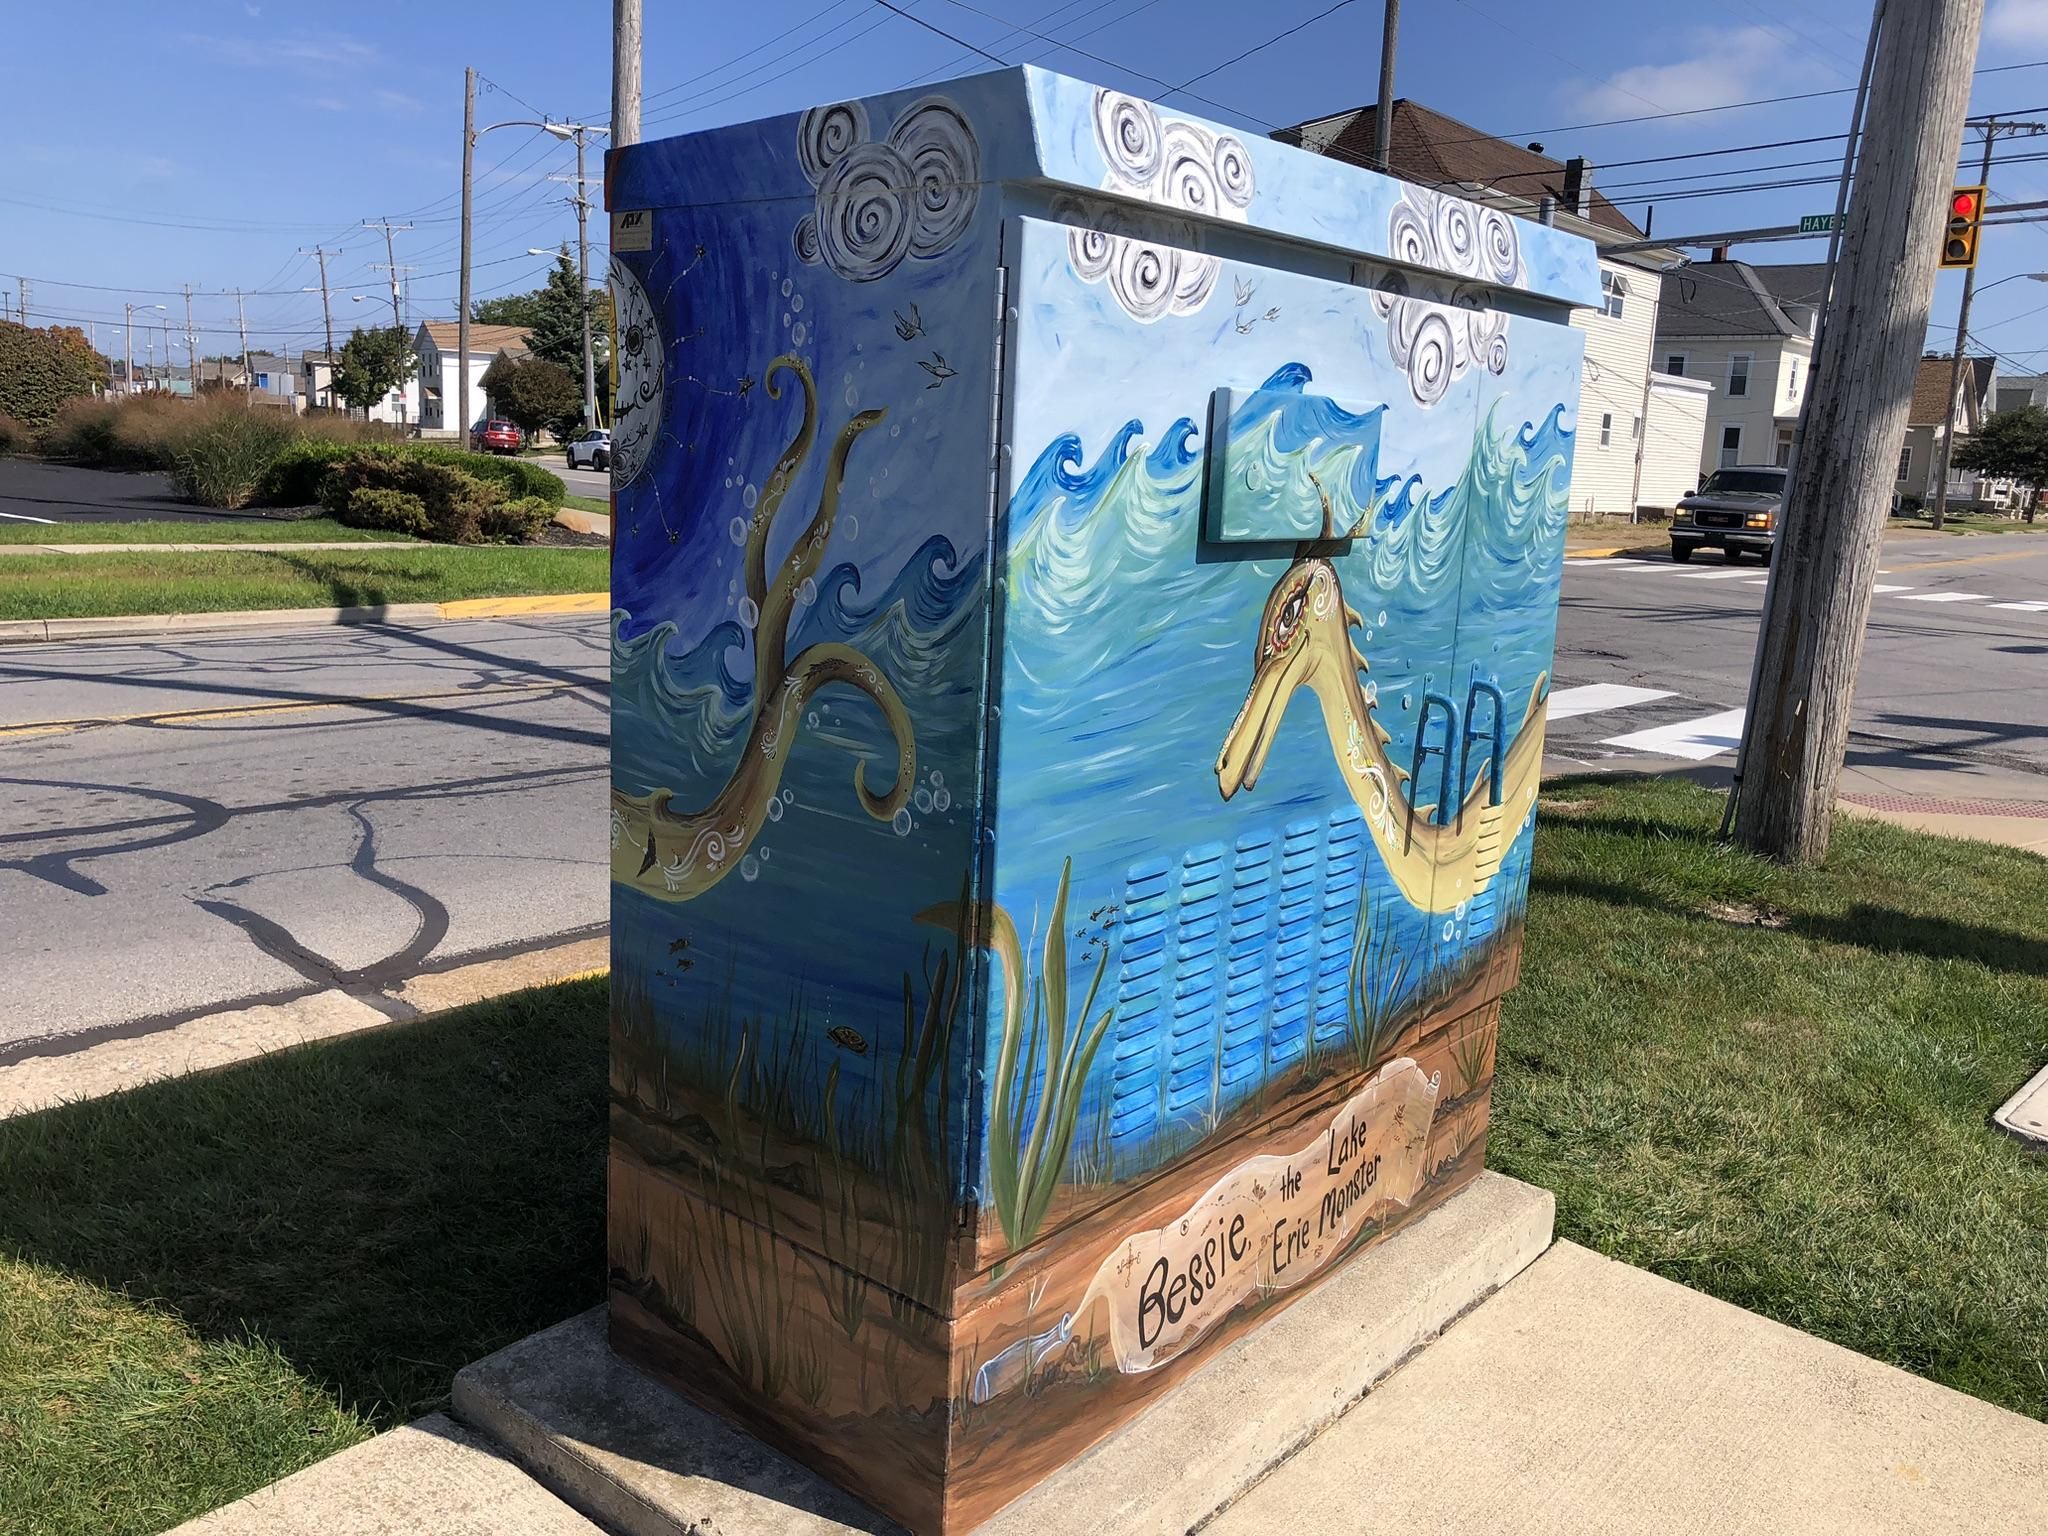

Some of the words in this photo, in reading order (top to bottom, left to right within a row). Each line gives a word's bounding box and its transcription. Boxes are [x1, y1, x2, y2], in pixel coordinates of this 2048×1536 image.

[1273, 1217, 1310, 1275] Erie
[1318, 1154, 1382, 1238] Monster
[1280, 1165, 1302, 1203] the
[1327, 1114, 1367, 1176] Lake
[1138, 1212, 1251, 1350] Bessie,
